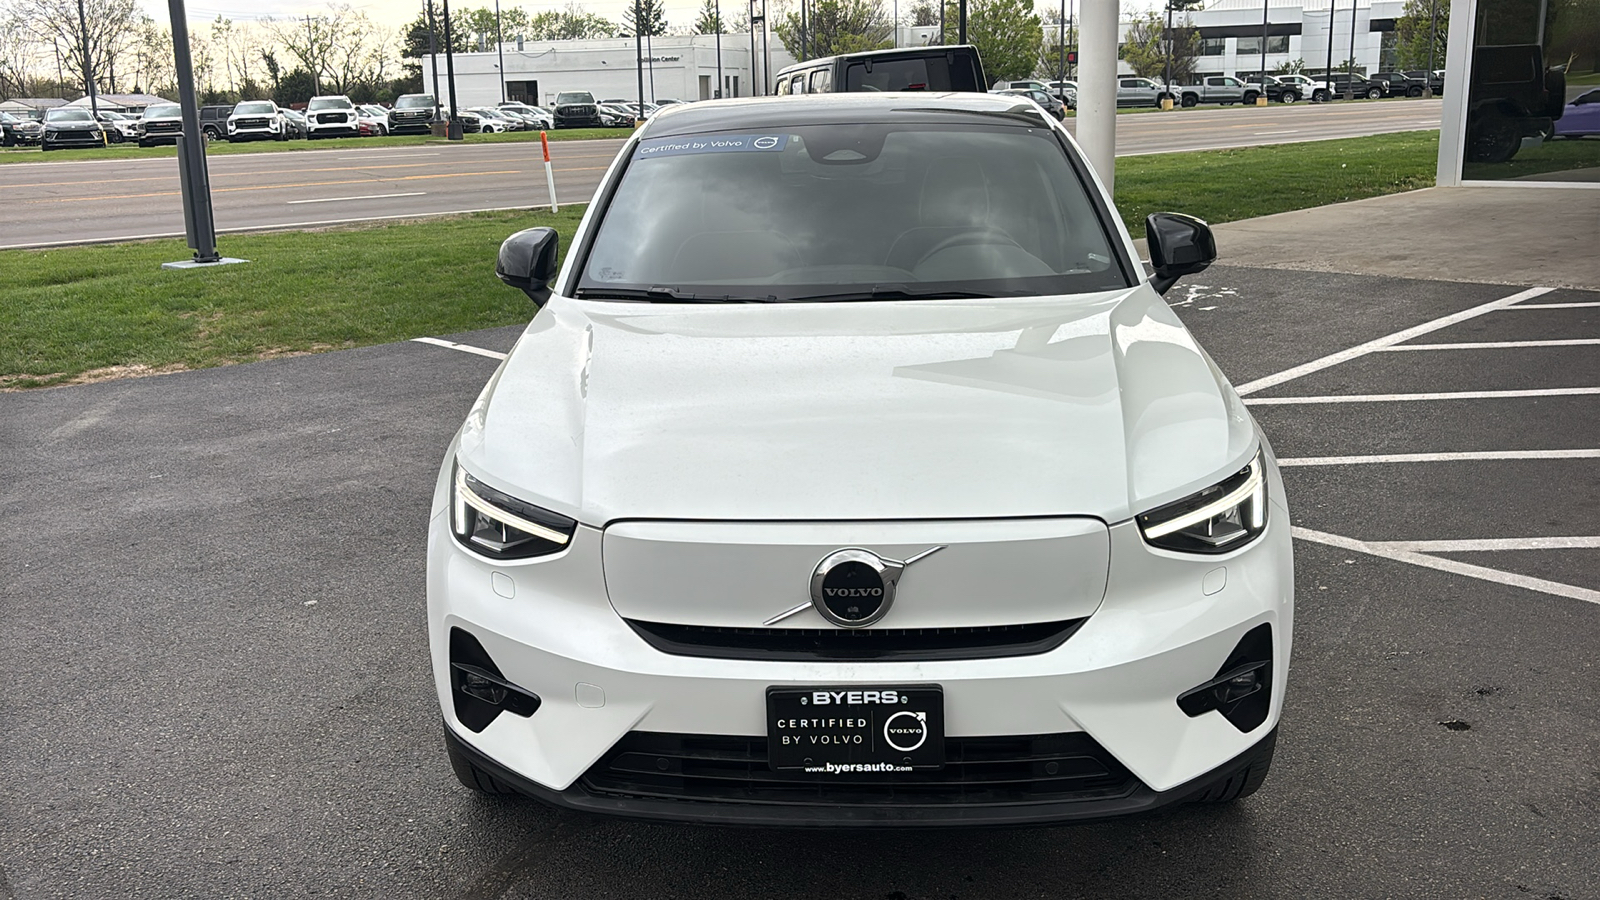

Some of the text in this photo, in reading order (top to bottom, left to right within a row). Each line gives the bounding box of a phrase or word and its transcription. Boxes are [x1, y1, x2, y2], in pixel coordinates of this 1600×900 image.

[641, 139, 743, 154] Certified by Volvo
[824, 587, 882, 597] VOLVO
[812, 690, 899, 705] BYERS
[777, 718, 867, 729] CERTIFIED
[782, 735, 863, 745] BY VOLVO
[805, 762, 913, 774] www.byersauto.com
